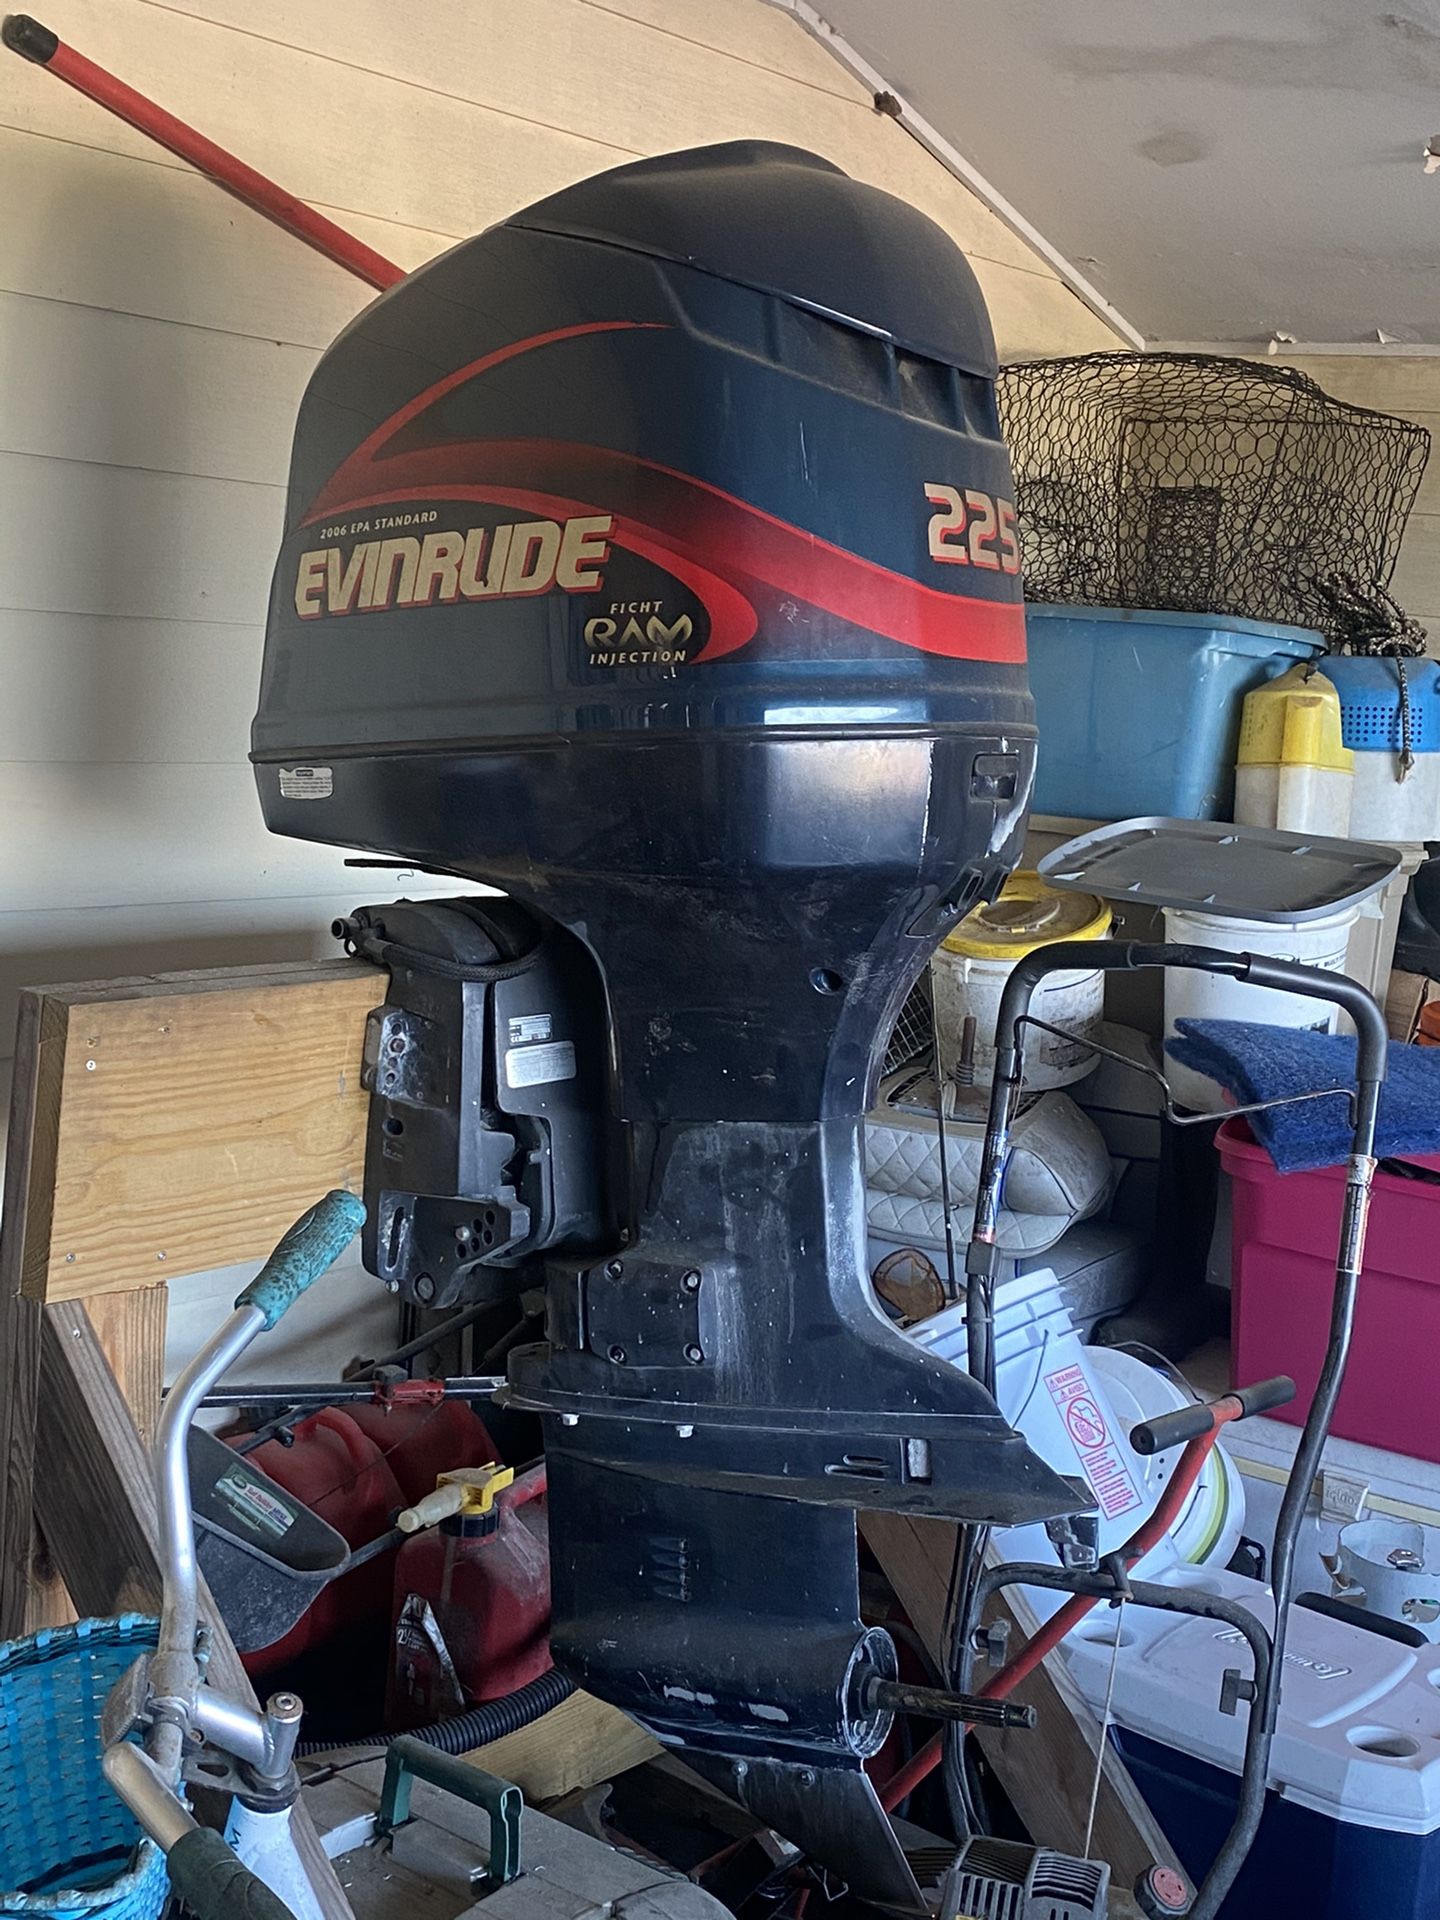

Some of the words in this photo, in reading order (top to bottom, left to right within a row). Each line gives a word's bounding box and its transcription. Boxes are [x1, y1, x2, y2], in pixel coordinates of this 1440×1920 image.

[320, 525, 347, 540] 2006
[350, 521, 370, 534] EPA
[374, 511, 437, 530] STANDARD
[923, 482, 1019, 575] 225
[295, 516, 615, 620] EVINRUDE
[610, 600, 662, 614] FICHT
[584, 614, 693, 648] RAM
[589, 650, 686, 666] INJECTION
